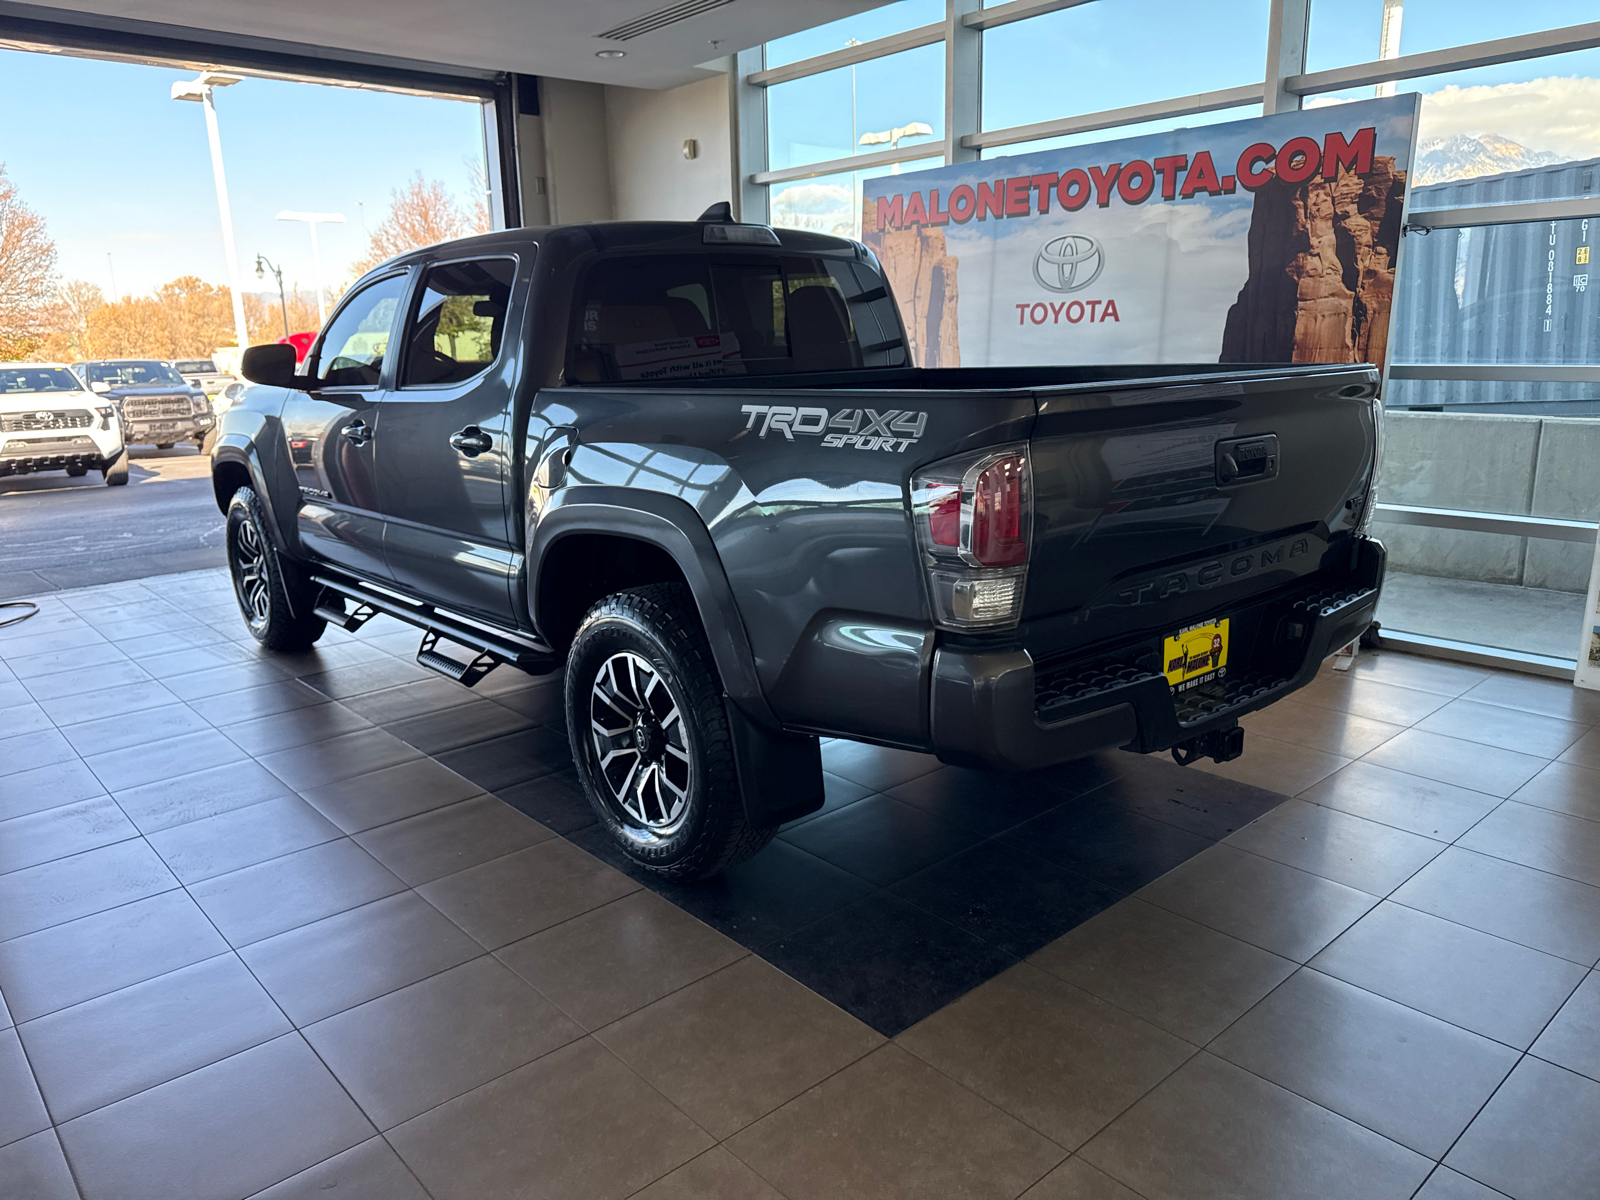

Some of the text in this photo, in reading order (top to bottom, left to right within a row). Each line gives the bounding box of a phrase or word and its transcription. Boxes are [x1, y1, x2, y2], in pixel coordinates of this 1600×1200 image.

[877, 127, 1378, 232] MALONETOYOTA.COM
[1546, 250, 1555, 315] 081884
[1016, 299, 1120, 325] TOYOTA
[740, 404, 828, 441] TRD
[820, 434, 918, 453] SPORT
[1119, 538, 1308, 605] TACOMA
[1213, 638, 1220, 648] 32
[1178, 684, 1186, 692] WE
[1186, 678, 1198, 689] MAKE
[1204, 672, 1215, 682] EASY
